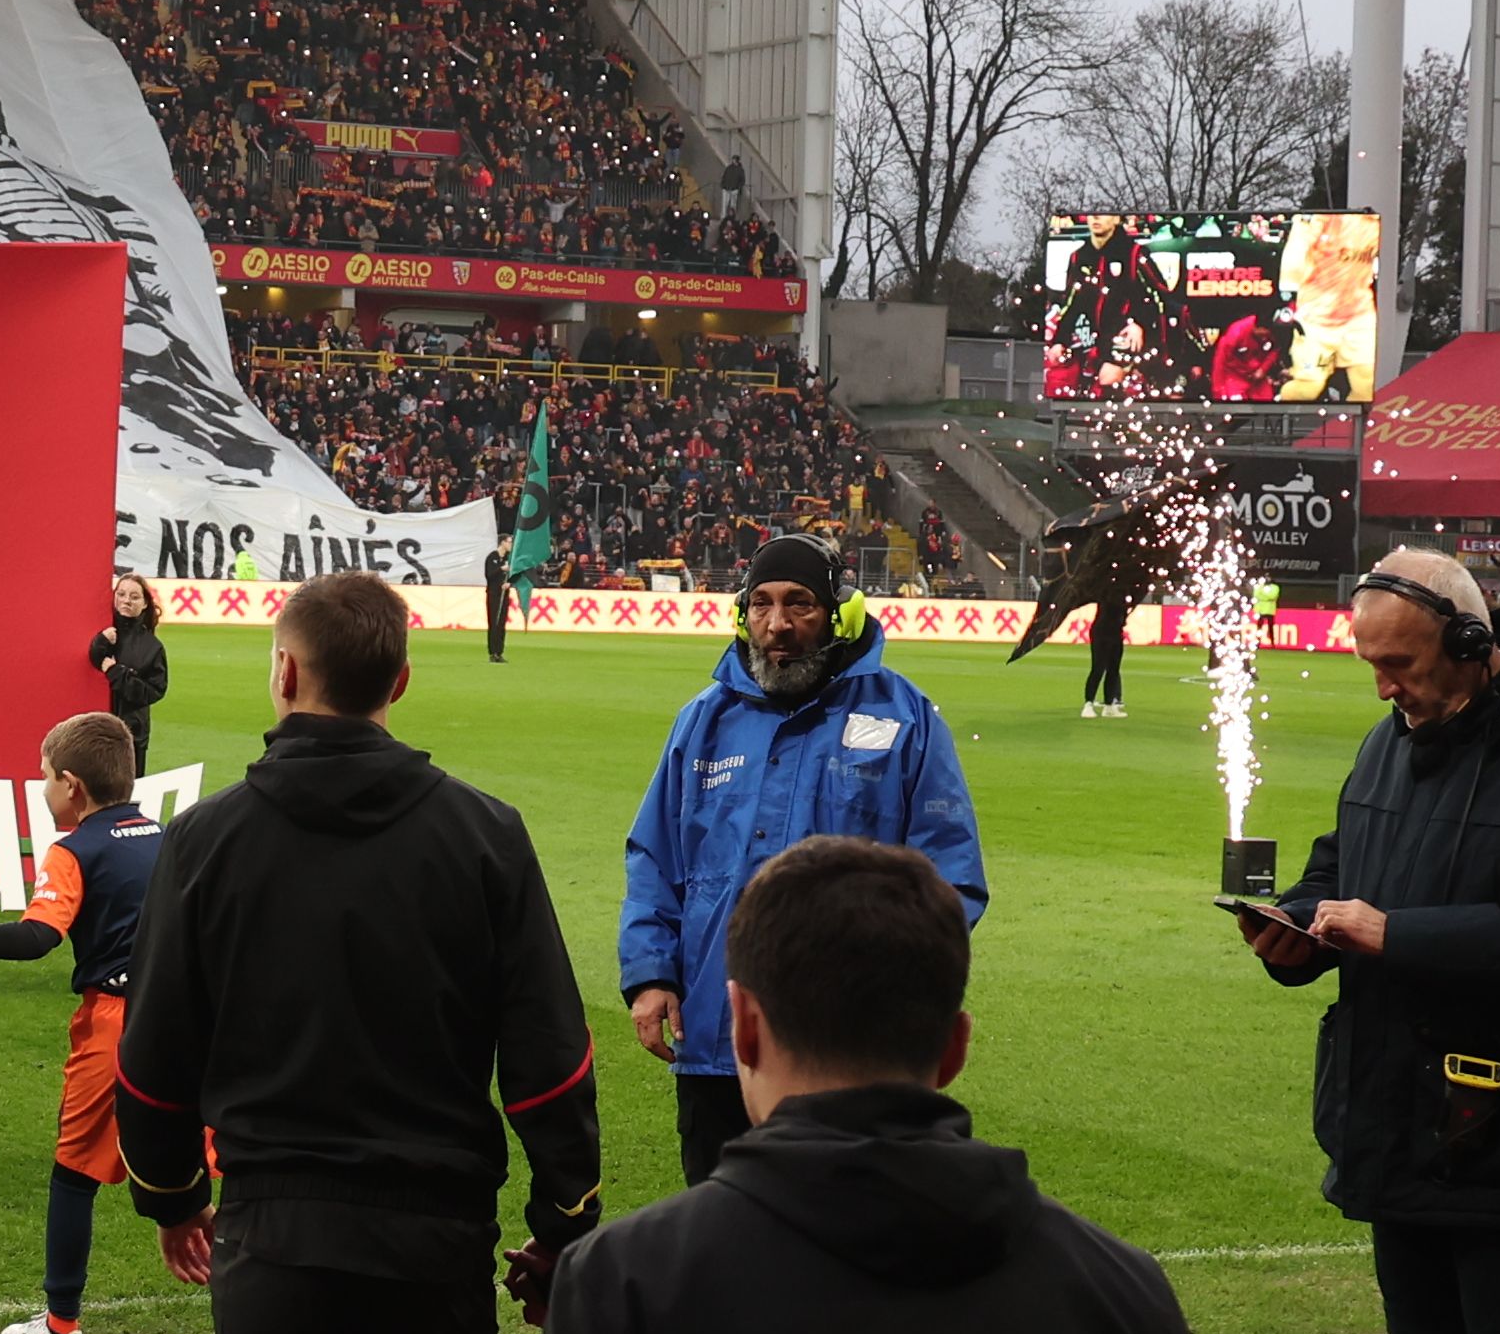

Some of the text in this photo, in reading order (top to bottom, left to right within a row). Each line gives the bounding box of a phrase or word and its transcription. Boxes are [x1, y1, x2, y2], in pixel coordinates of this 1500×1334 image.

[326, 123, 392, 150] PUMA
[270, 252, 330, 272] AÉSIO
[373, 258, 432, 278] AÉSIO
[269, 270, 325, 283] MUTUELLE
[372, 275, 428, 288] MUTUELLE
[1187, 280, 1273, 297] LENSOIS
[1226, 492, 1332, 529] MOTO
[1253, 531, 1309, 546] VALLEY
[280, 514, 432, 586] AÎNÉS
